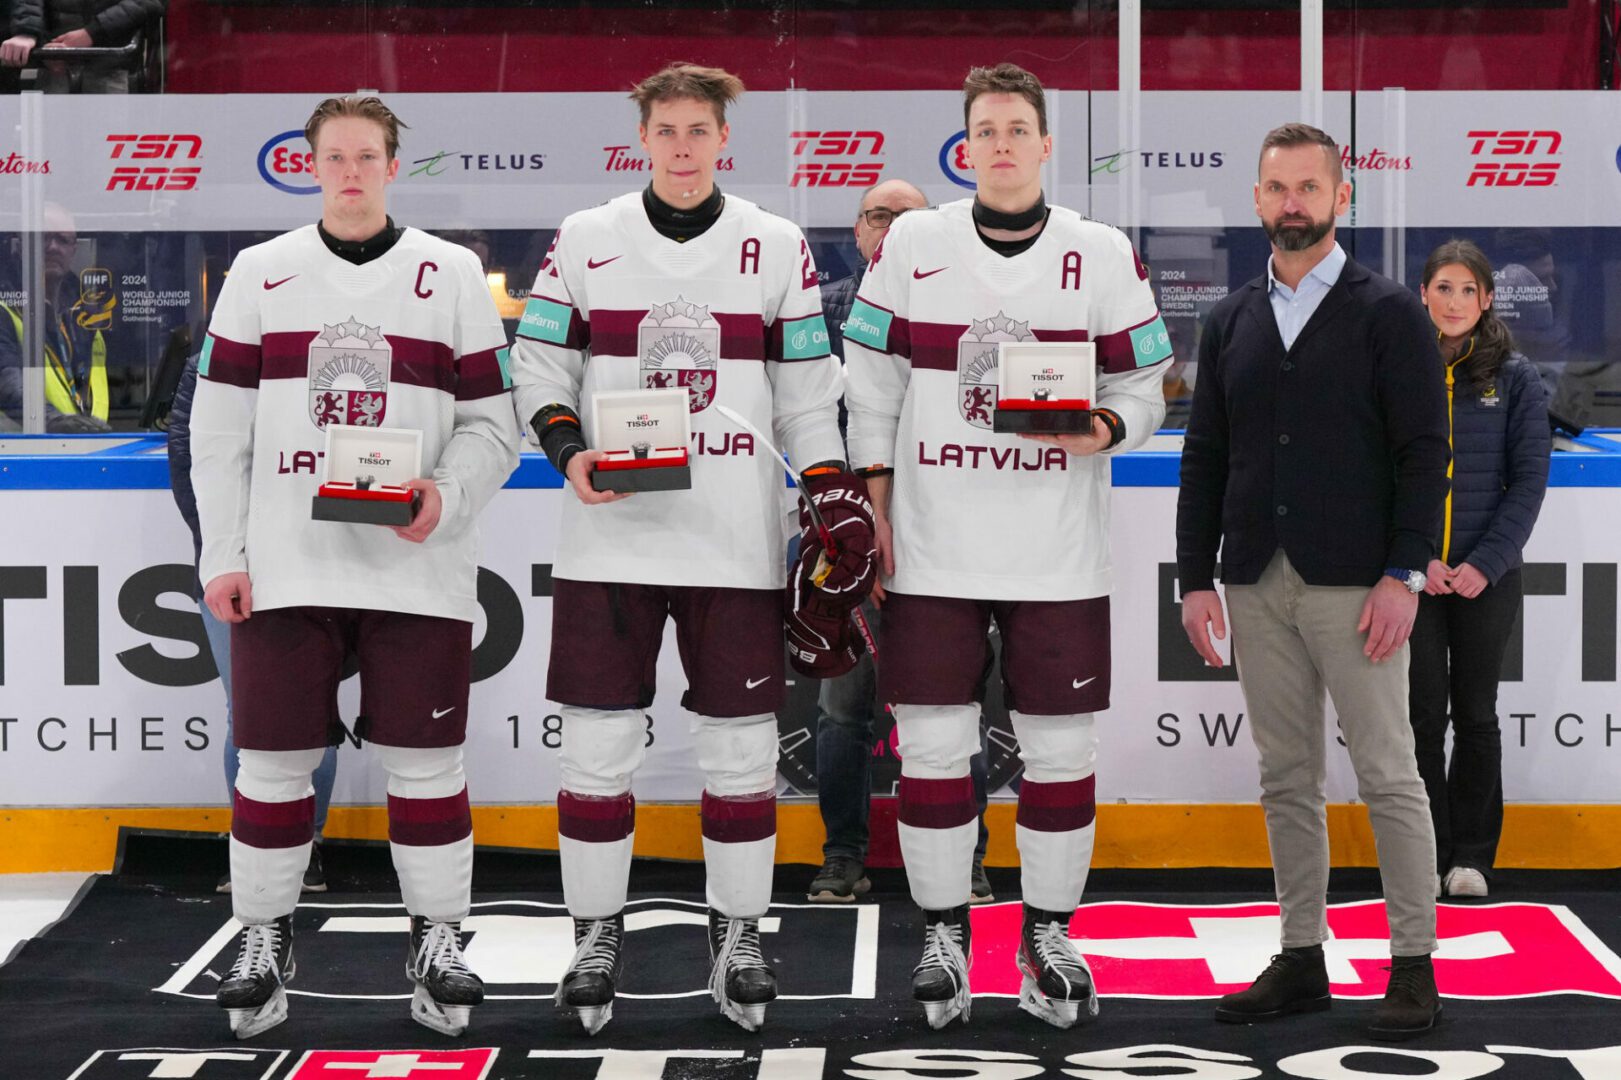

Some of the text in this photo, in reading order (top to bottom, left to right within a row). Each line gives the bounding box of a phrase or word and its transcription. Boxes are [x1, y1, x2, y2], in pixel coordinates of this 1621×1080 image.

[106, 134, 202, 159] TSN
[790, 131, 884, 155] TSN
[1467, 131, 1562, 155] TSN
[460, 154, 543, 170] TELUS
[603, 146, 644, 171] Tim
[1141, 152, 1223, 168] TELUS
[1335, 144, 1411, 170] Hrtons
[740, 238, 761, 274] A
[1061, 251, 1082, 290] A
[1161, 271, 1185, 280] 2024
[84, 275, 108, 284] IIHF
[122, 275, 147, 285] 2024
[414, 261, 438, 299] C
[122, 290, 190, 299] WORLD JUNIOR
[1161, 286, 1228, 294] WORLD JUNIOR
[1494, 294, 1548, 302] AMPIONSHIP
[1515, 286, 1549, 294] JUNIOR
[626, 420, 659, 428] TISSOT
[358, 457, 391, 466] TISSOT
[919, 441, 1067, 471] LATVIJA
